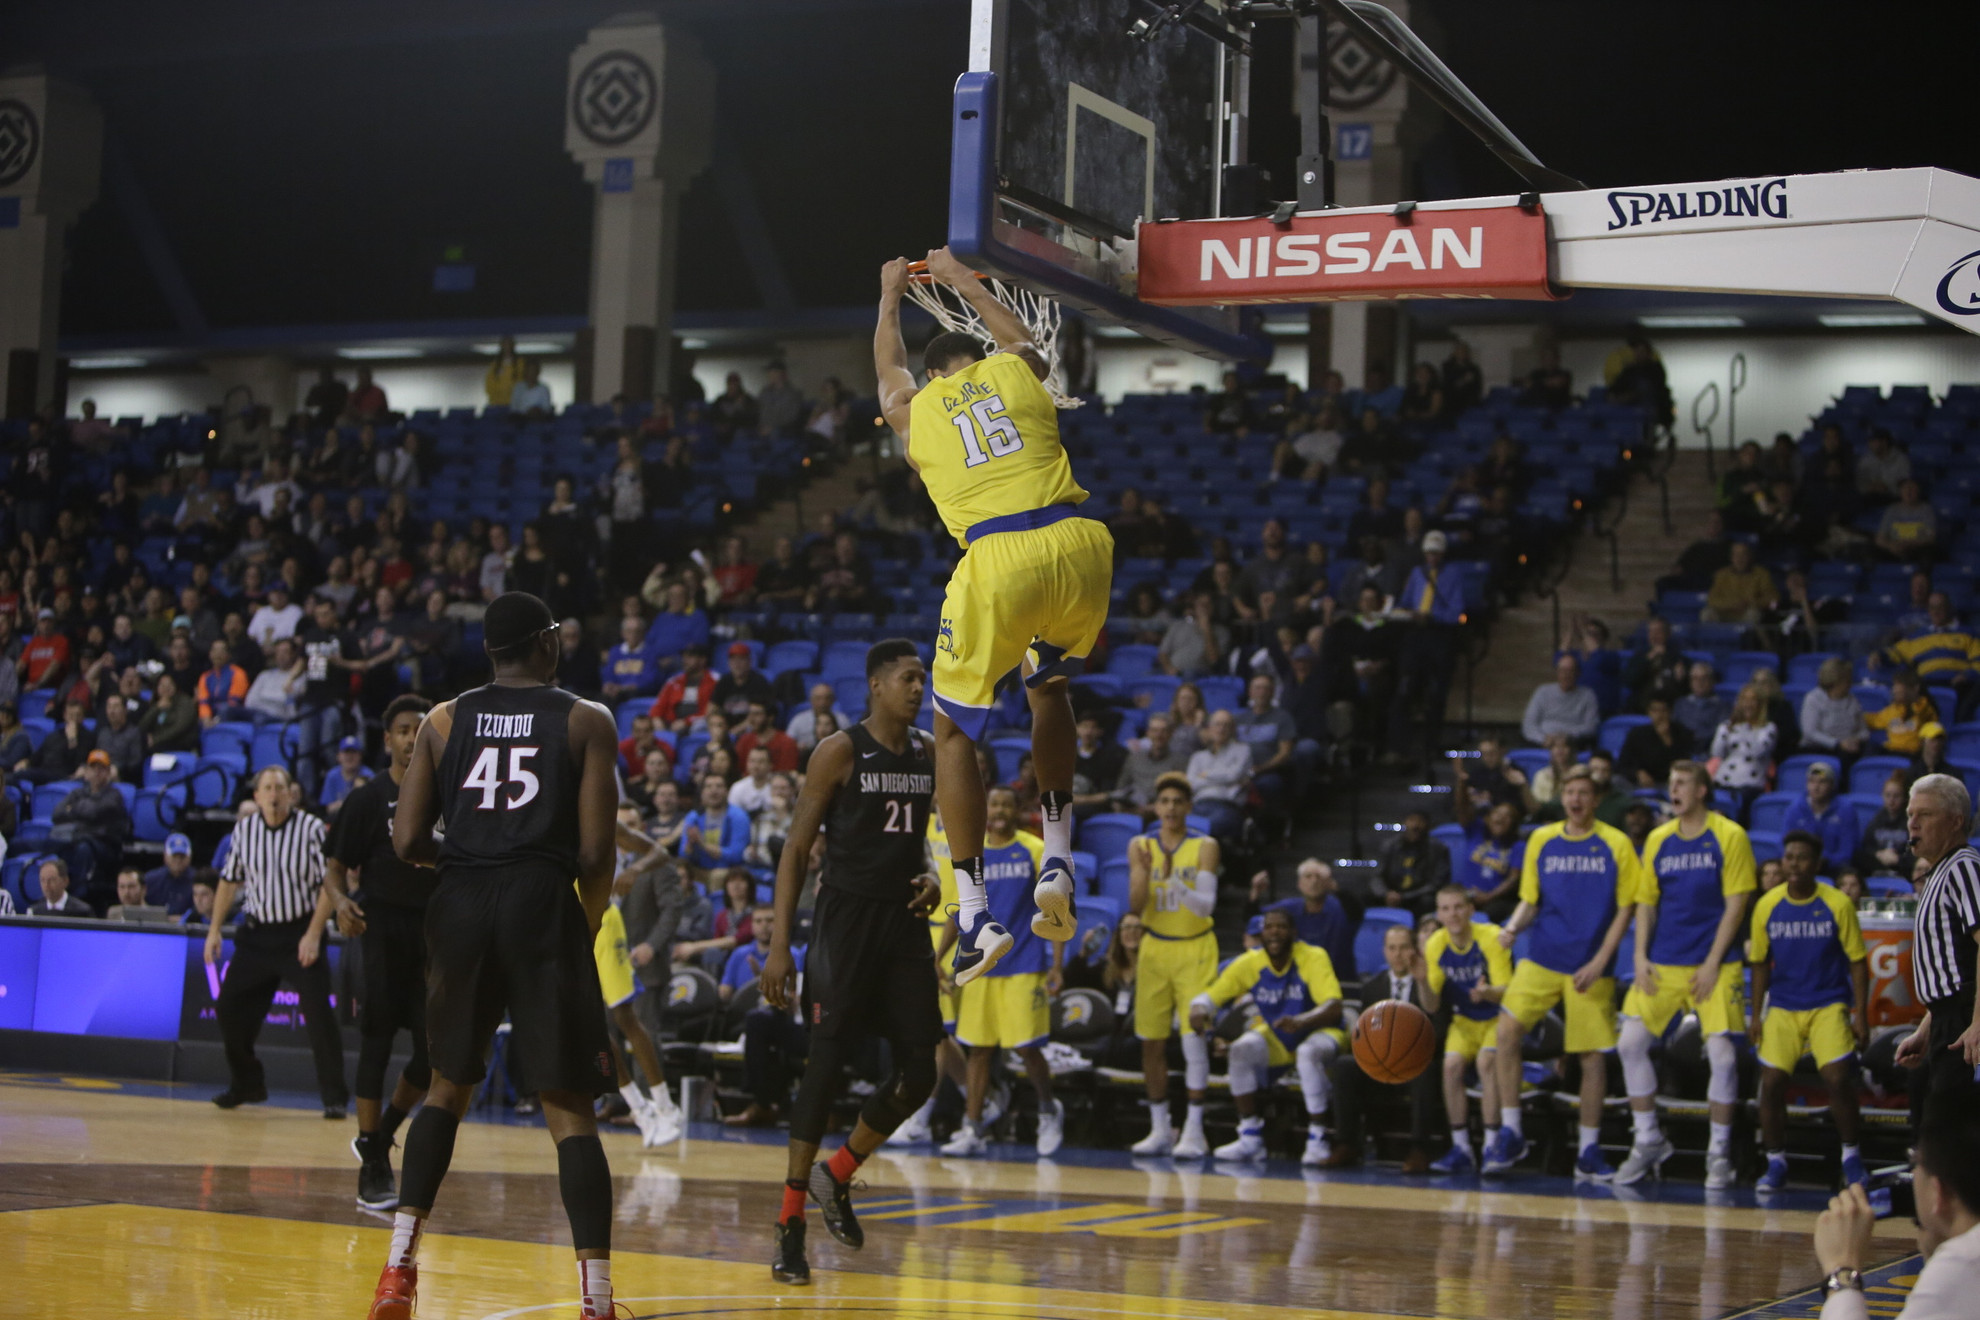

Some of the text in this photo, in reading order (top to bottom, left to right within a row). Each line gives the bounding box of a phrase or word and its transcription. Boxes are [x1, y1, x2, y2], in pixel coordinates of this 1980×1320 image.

[1341, 130, 1369, 156] 17
[1608, 179, 1788, 231] SPALDING
[1200, 227, 1483, 281] NISSAN
[951, 394, 1025, 469] 15
[475, 713, 534, 738] IZUNDU
[460, 745, 541, 811] 45
[860, 772, 932, 794] SAN DIEGO STATE
[883, 800, 913, 833] 21
[984, 861, 1031, 881] ARTANS
[1544, 856, 1606, 874] SPARTANS
[1659, 853, 1717, 874] SPARTAN
[1769, 921, 1833, 940] SPARTANS
[1870, 944, 1899, 979] G
